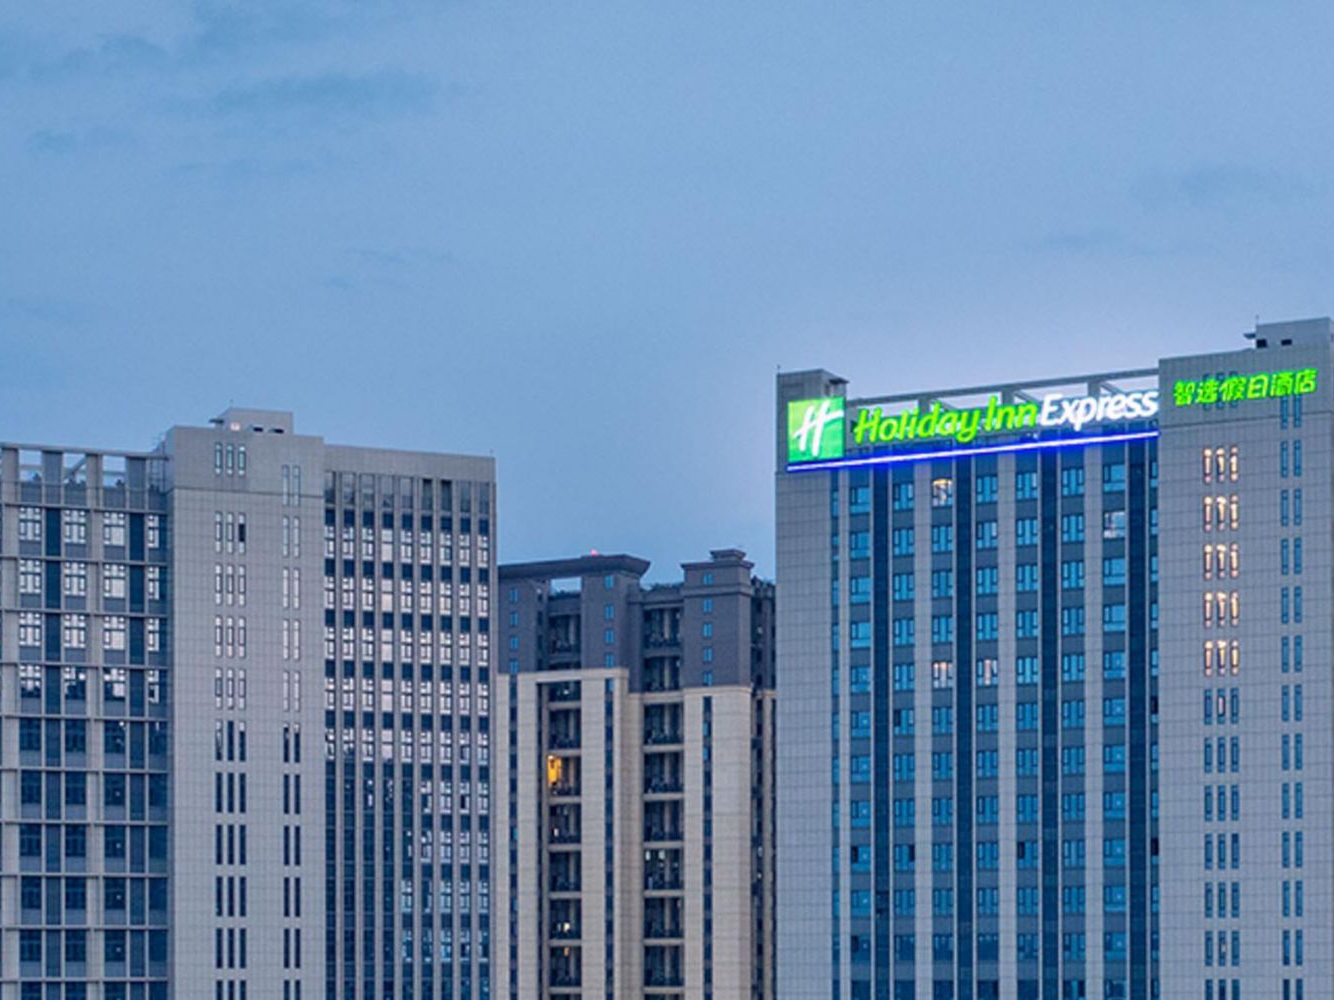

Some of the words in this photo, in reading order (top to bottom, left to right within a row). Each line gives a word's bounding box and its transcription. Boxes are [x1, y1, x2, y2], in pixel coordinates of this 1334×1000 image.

[1173, 367, 1319, 407] 智选假日酒店
[853, 402, 982, 444] Holiday
[984, 395, 1038, 432] Inn
[1040, 390, 1160, 431] Express
